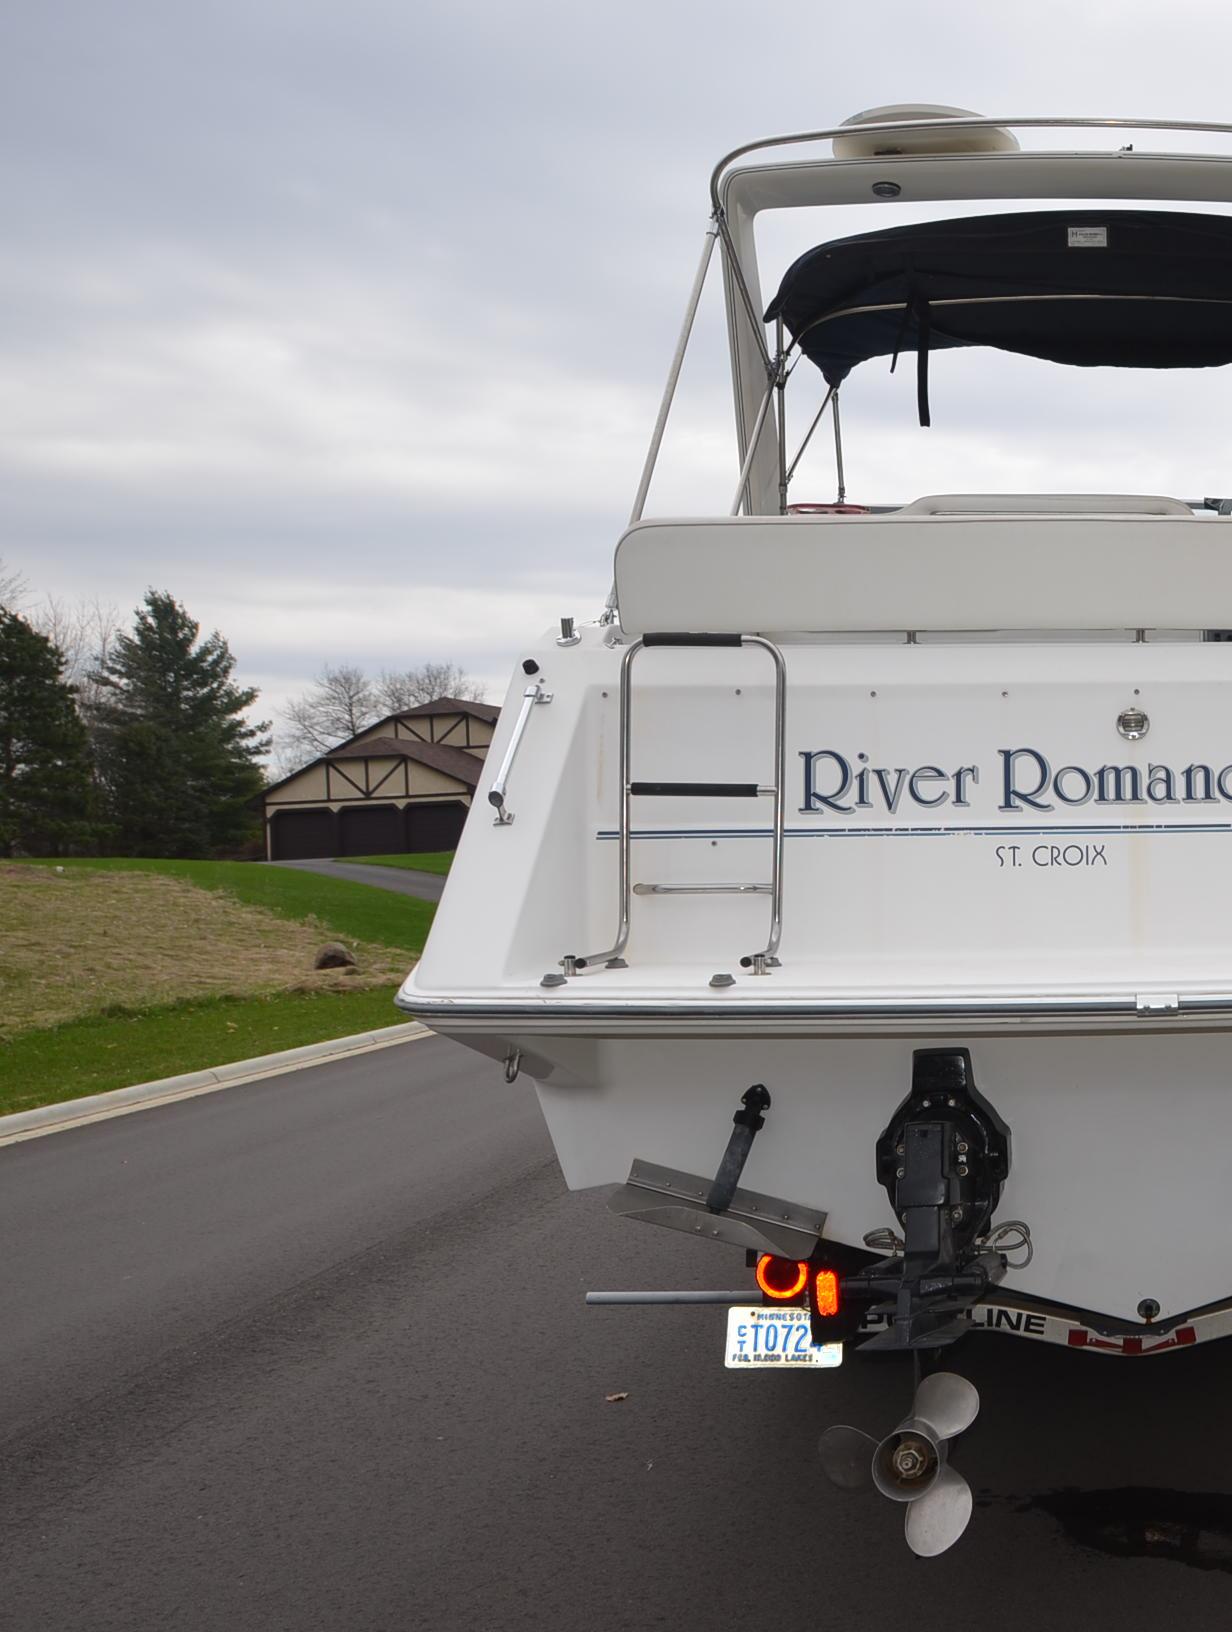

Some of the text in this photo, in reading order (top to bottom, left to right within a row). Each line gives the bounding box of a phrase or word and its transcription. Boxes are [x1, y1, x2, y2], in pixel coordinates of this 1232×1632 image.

[798, 749, 979, 815] River
[995, 844, 1107, 867] ST. CROIX
[756, 1312, 812, 1322] MINNESOT
